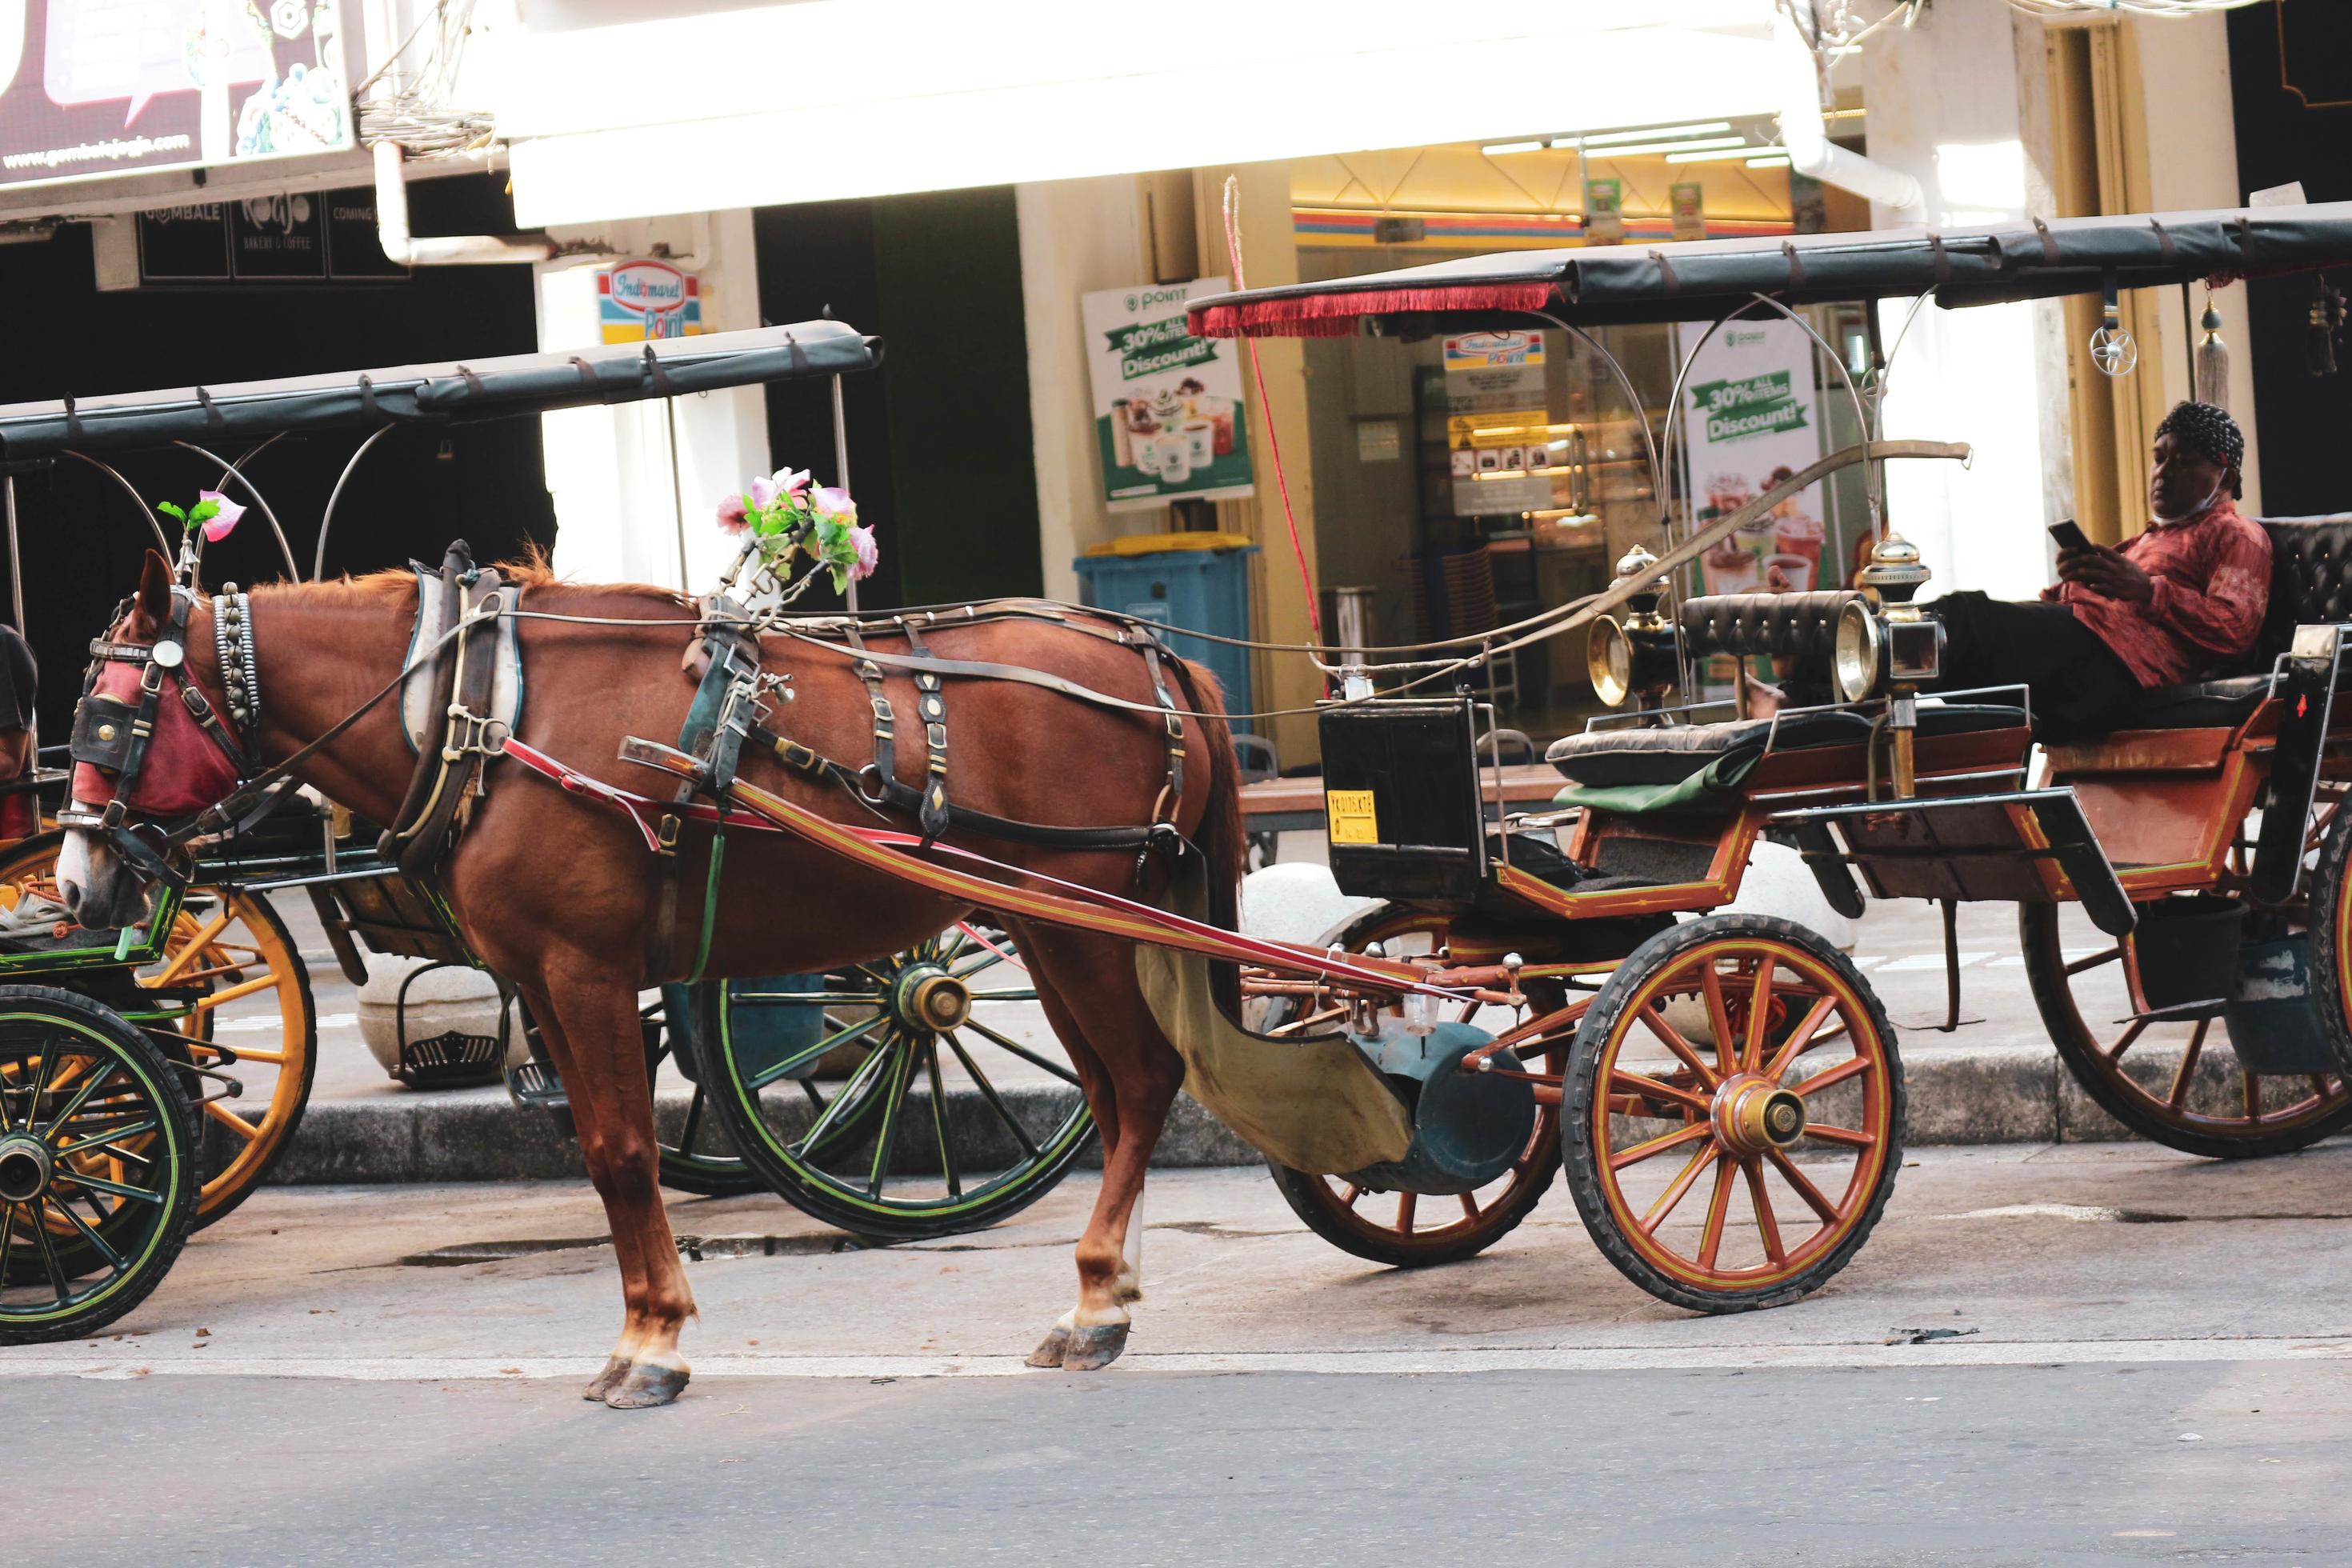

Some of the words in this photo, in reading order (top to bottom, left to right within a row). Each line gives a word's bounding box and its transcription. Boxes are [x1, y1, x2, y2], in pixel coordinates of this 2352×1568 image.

[333, 206, 372, 221] COMING
[615, 274, 681, 298] Indomaret
[645, 309, 684, 339] Point
[1165, 317, 1184, 330] ALL
[1122, 324, 1166, 351] 30%
[1123, 338, 1207, 377] Discount!
[1487, 351, 1525, 365] Point
[1753, 375, 1774, 389] ALL
[1753, 383, 1788, 399] ITEMS
[1709, 382, 1754, 410] 30%
[1708, 402, 1798, 439] Discount!
